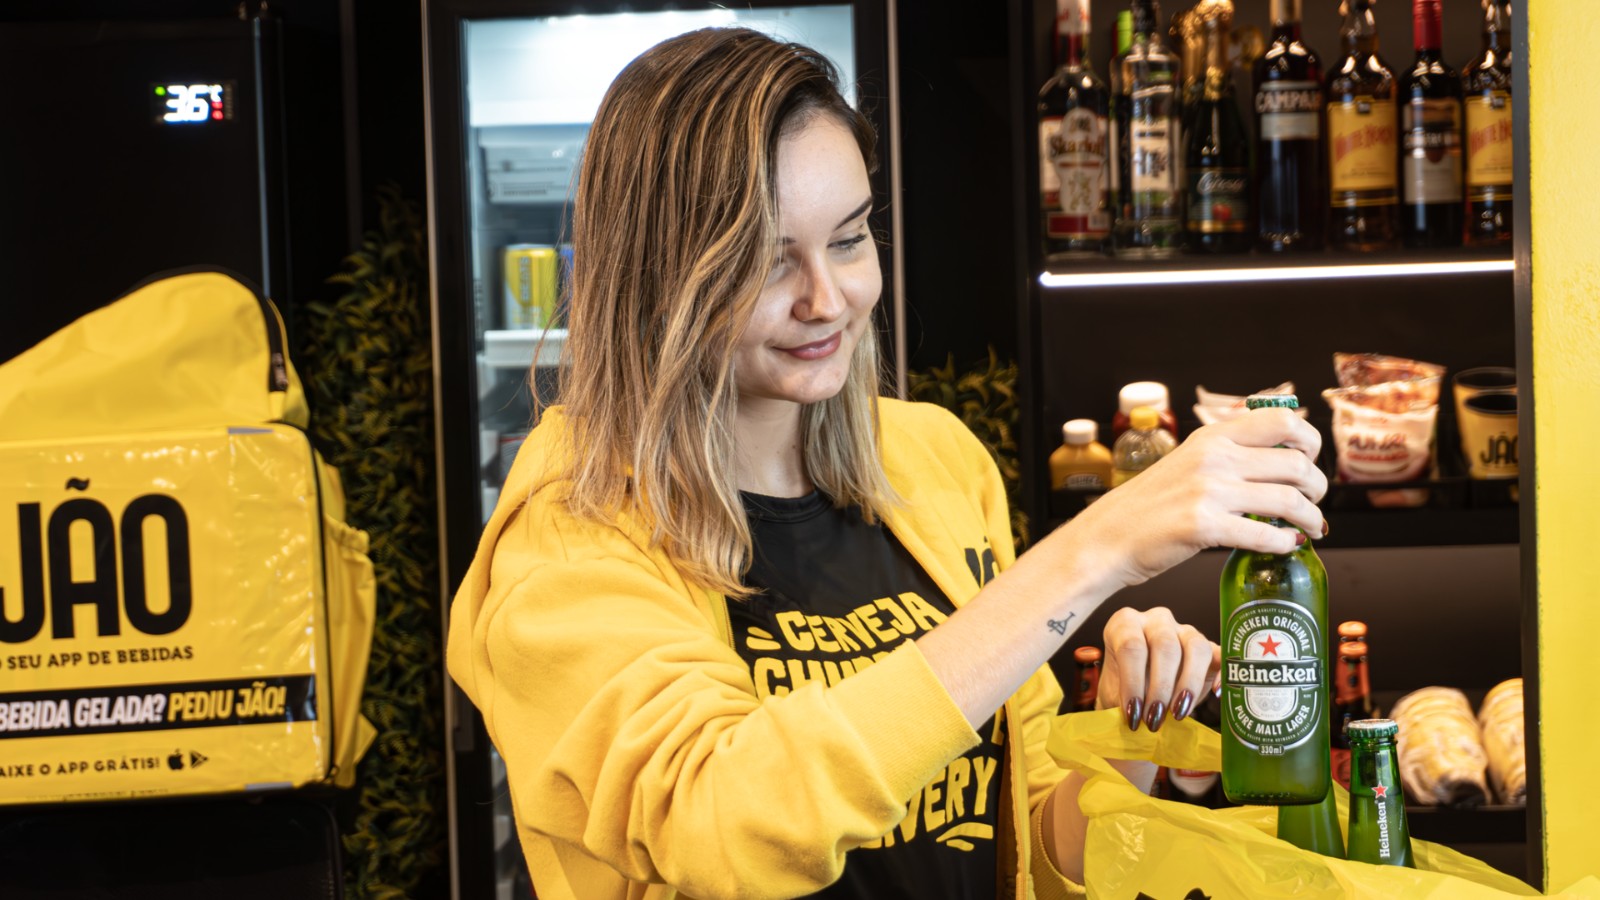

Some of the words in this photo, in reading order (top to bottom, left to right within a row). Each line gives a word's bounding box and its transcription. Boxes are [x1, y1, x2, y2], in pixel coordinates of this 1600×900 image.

[0, 477, 192, 643] JÃO
[775, 591, 951, 652] CERVEJA
[1232, 615, 1269, 651] HEINEKEN
[1272, 615, 1310, 651] ORIGINAL
[7, 654, 42, 670] SEU
[47, 652, 83, 668] APP
[87, 650, 112, 666] DE
[116, 645, 194, 664] BEBIDAS
[1228, 663, 1317, 683] Heineken
[0, 699, 72, 732] BEBIDA
[74, 693, 167, 727] GELADA?
[167, 689, 234, 722] PEDIU
[236, 681, 287, 718] JÃO!
[1234, 705, 1254, 730] PURE
[1255, 723, 1282, 736] MALT
[1285, 704, 1311, 733] LAGER
[39, 763, 52, 776] O
[56, 761, 90, 776] APP
[94, 755, 161, 773] GRÁTIS!
[1260, 745, 1282, 754] 330ml
[1377, 801, 1390, 858] Heineken
